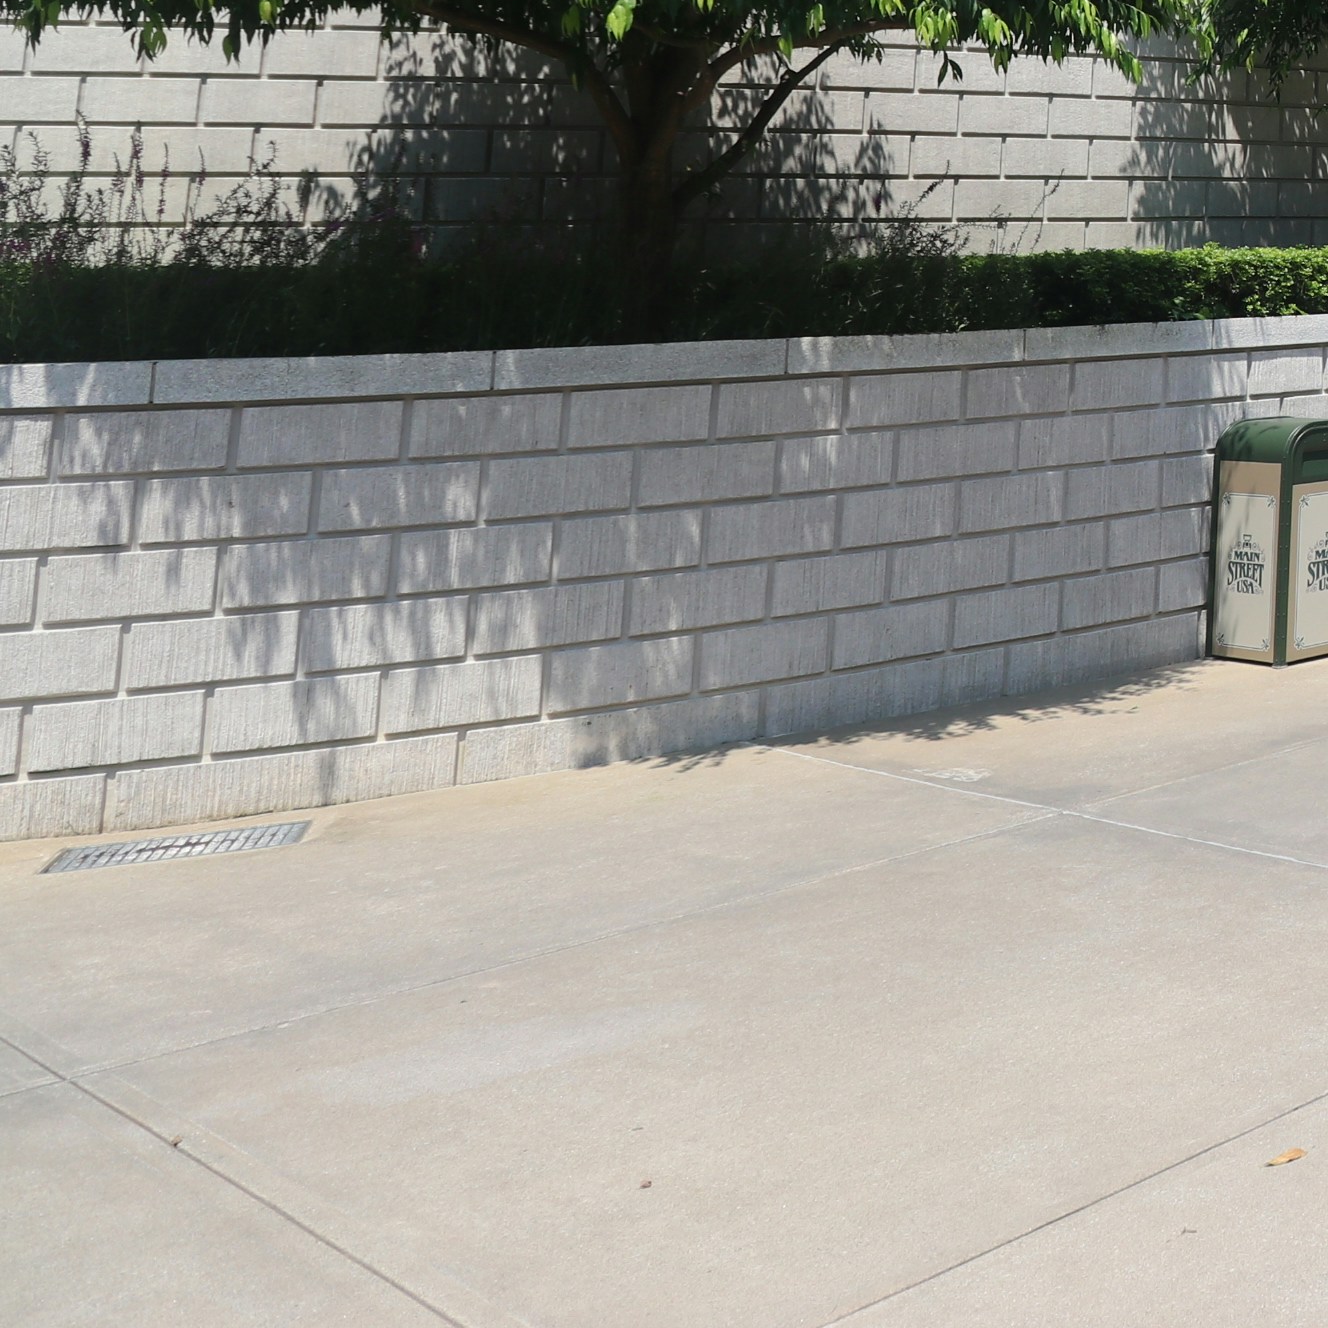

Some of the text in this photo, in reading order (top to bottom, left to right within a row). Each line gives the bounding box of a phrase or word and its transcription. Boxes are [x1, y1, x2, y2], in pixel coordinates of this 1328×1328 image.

[1233, 550, 1261, 562] MAIN
[1227, 561, 1264, 588] STREET
[1236, 579, 1254, 594] USA
